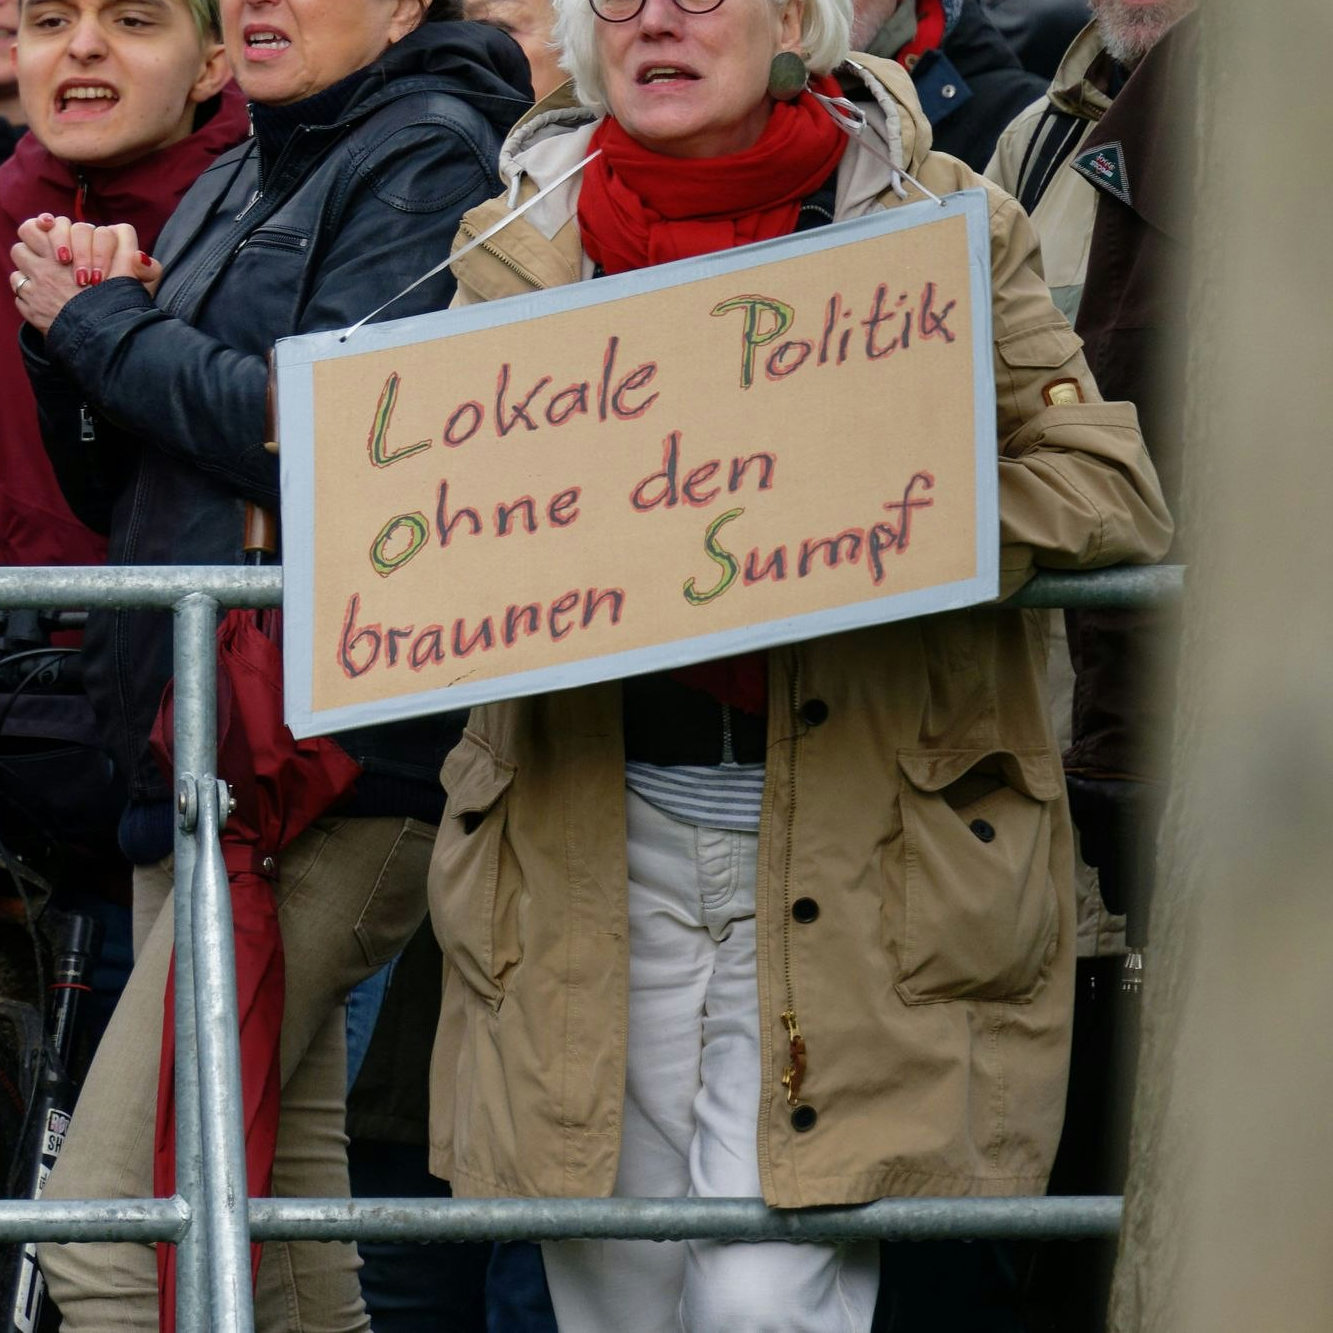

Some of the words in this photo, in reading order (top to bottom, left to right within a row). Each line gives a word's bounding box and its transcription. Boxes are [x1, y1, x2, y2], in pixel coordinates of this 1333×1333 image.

[367, 335, 661, 469] Lokale
[710, 280, 958, 389] Politik
[337, 583, 625, 678] braunen
[682, 470, 934, 608] Sumpf
[370, 478, 582, 577] ohne
[629, 431, 777, 513] den
